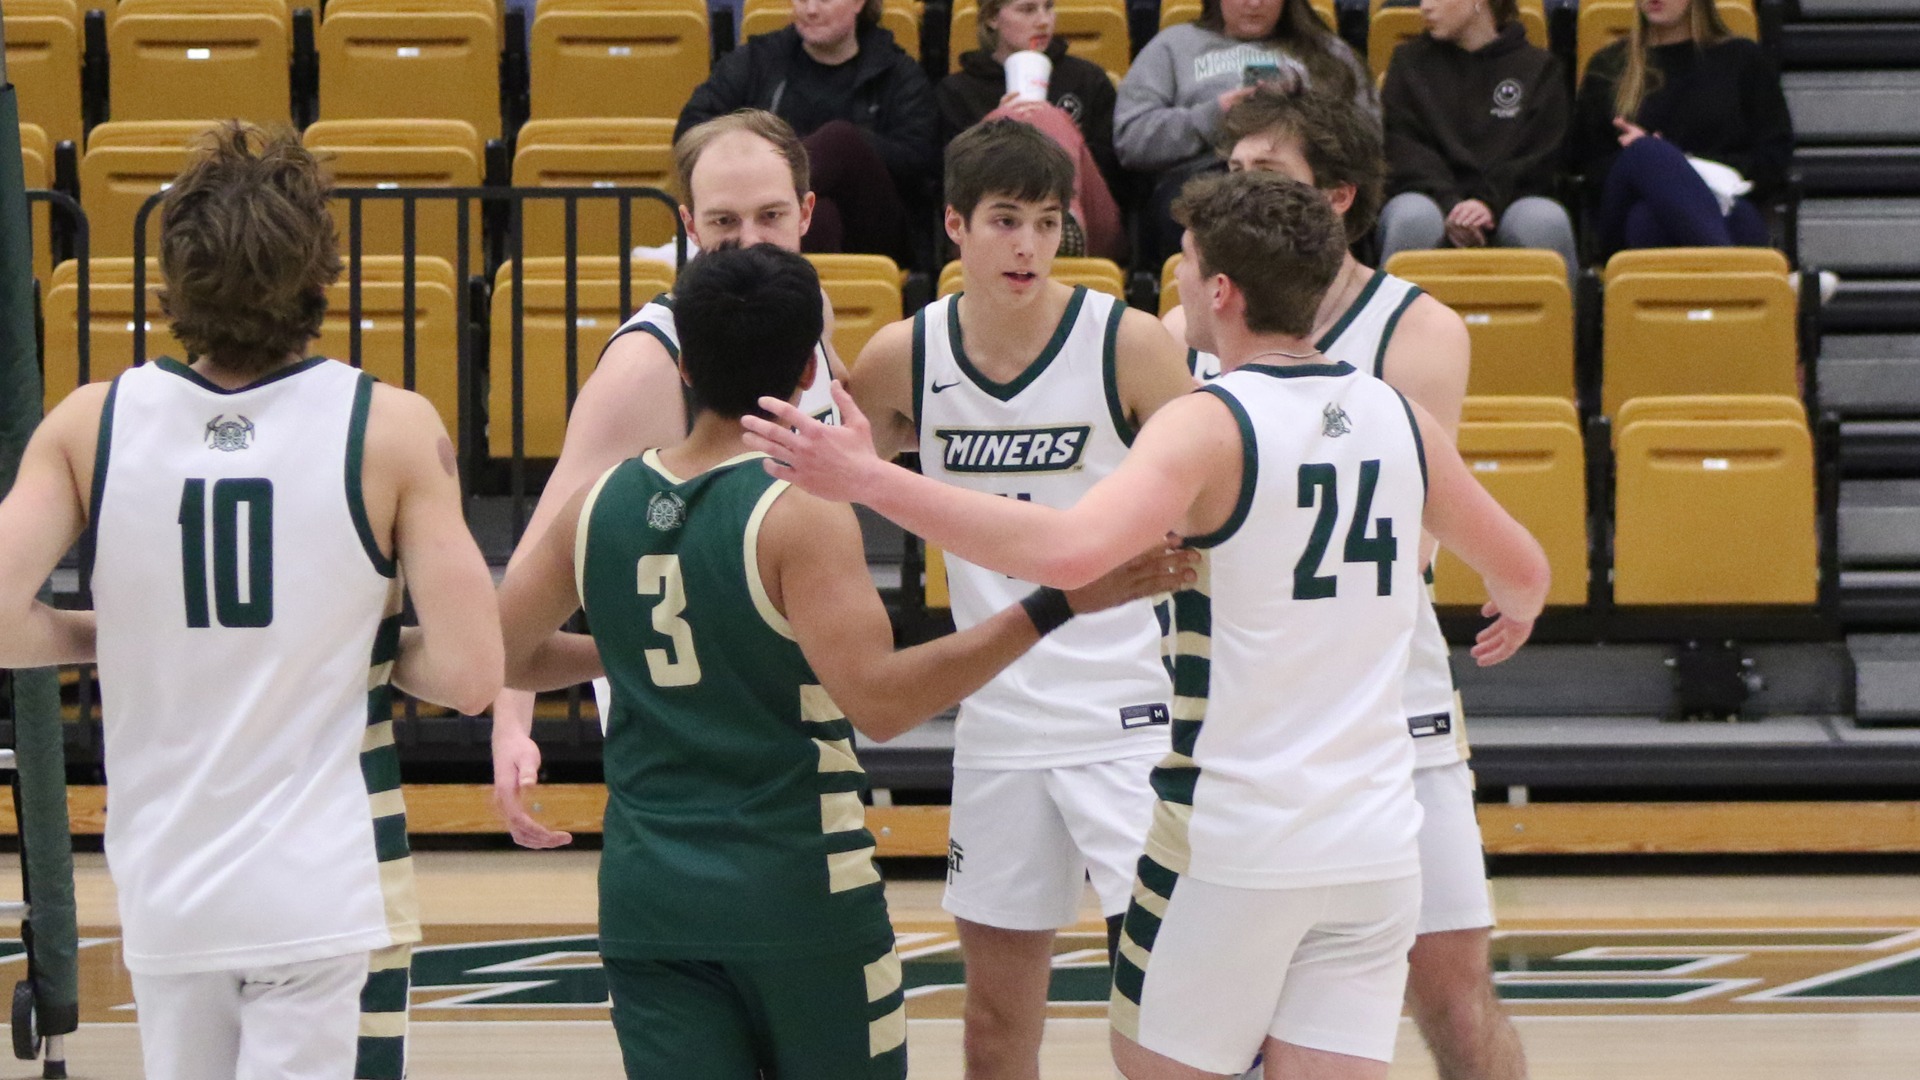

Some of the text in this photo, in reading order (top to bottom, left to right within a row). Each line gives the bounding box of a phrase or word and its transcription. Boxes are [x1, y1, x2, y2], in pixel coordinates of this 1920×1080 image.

[945, 430, 1081, 467] MINERS
[178, 477, 274, 628] 10
[1292, 459, 1398, 600] 24
[637, 554, 702, 687] 3
[1154, 709, 1164, 718] M
[1435, 719, 1448, 729] XL
